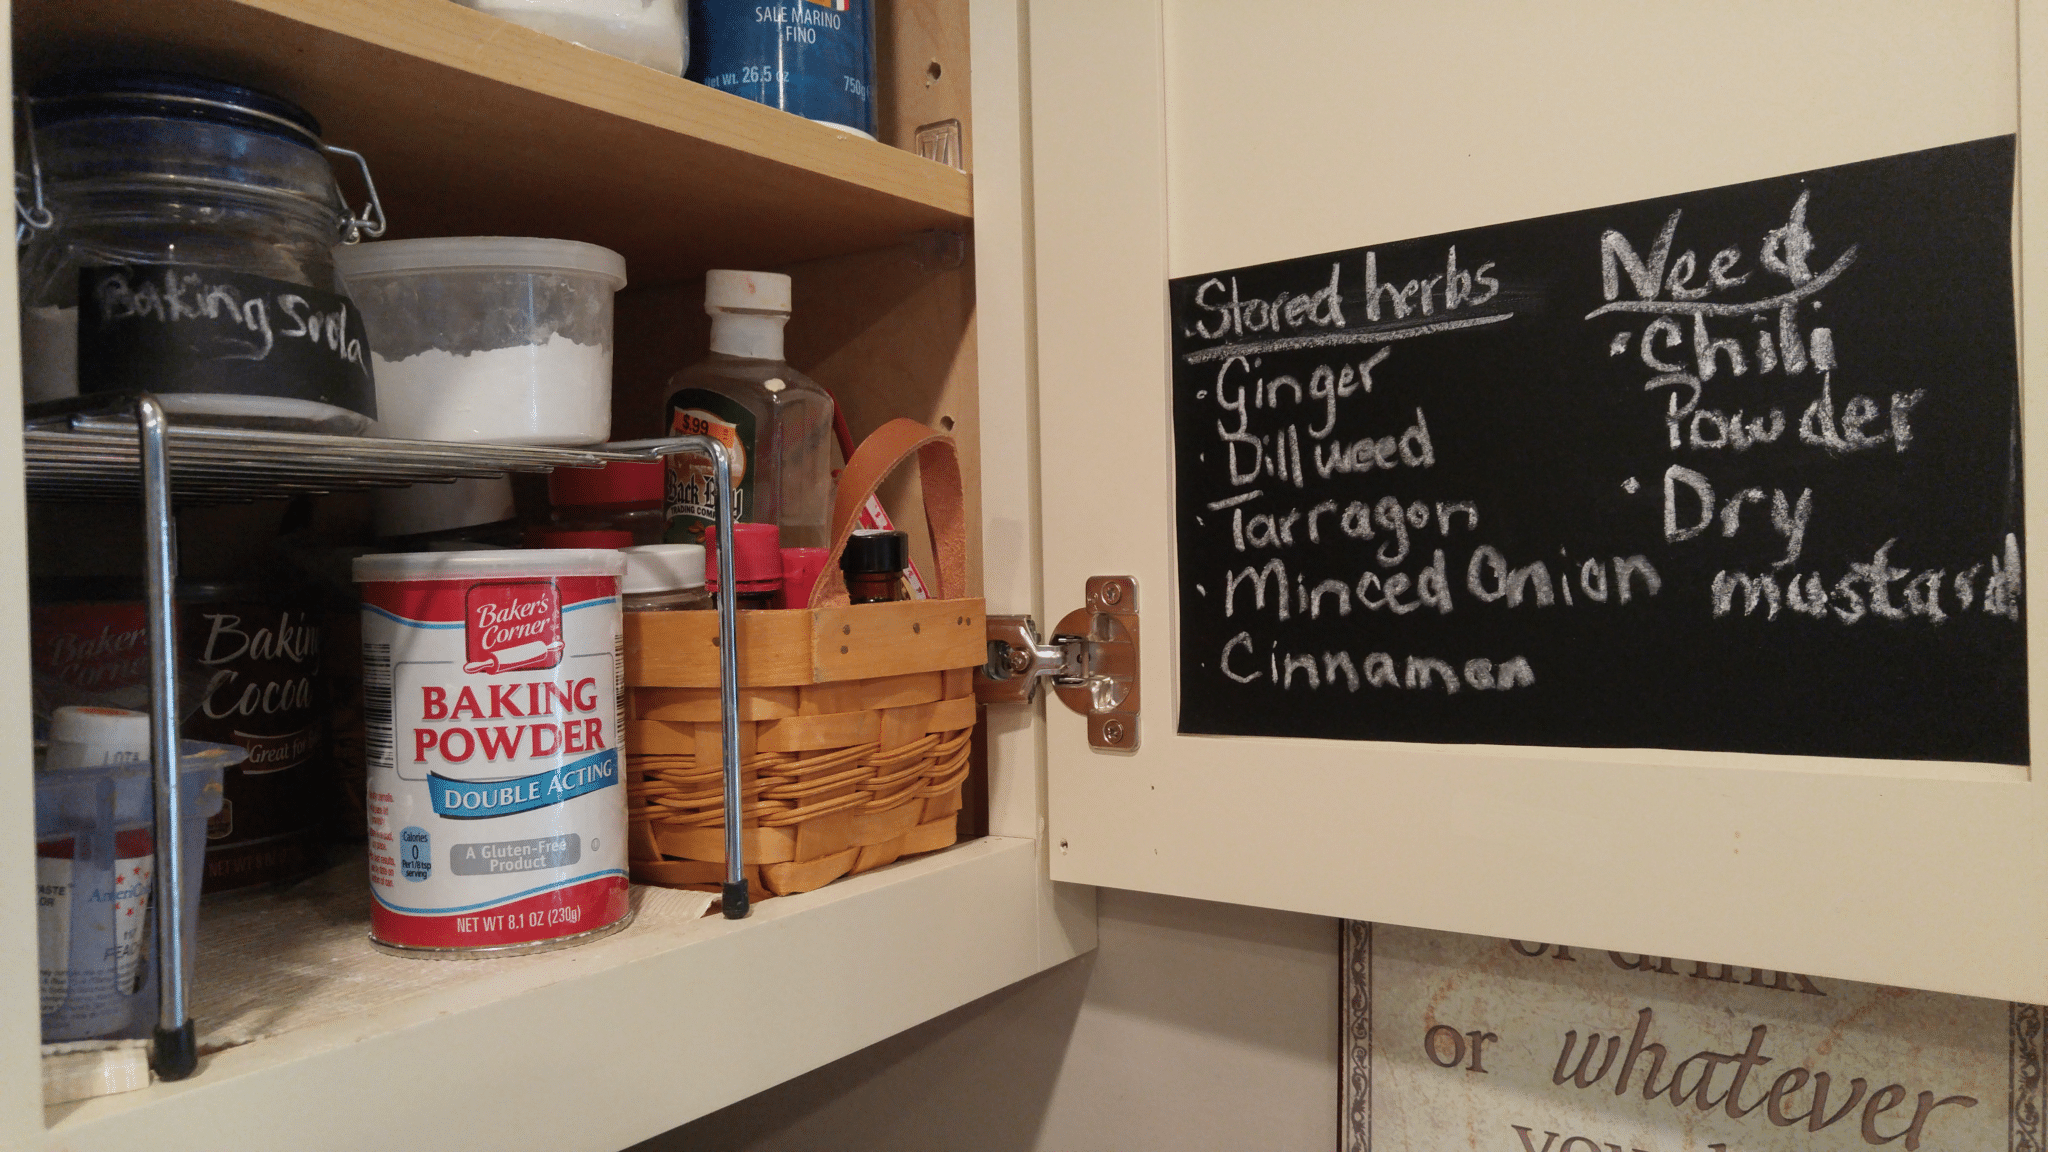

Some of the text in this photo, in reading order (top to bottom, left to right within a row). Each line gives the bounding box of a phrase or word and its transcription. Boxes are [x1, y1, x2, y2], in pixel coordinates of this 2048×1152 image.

[755, 6, 841, 31] SALE MARINO
[785, 26, 816, 44] FINO
[742, 65, 772, 84] 26.5
[1600, 189, 1815, 300] Need
[102, 269, 274, 361] Baking
[1195, 245, 1499, 340] Stored herbs
[1640, 298, 1838, 382] Chili
[1216, 346, 1391, 441] Ginger
[1645, 372, 1927, 460] Powder
[670, 503, 696, 516] TRADING
[1208, 490, 1479, 567] Tarragon
[1663, 464, 1813, 568] Dry
[1225, 544, 1662, 622] Minced Onion
[1711, 532, 2019, 624] mustard
[476, 593, 549, 629] Baker's
[481, 617, 551, 650] Corner
[1220, 631, 1535, 695] Cinnamon
[202, 668, 313, 720] Cocoa
[420, 677, 598, 721] BAKING
[248, 743, 290, 765] Great
[413, 717, 606, 763] POWDER
[444, 759, 613, 809] DOUBLE ACTING
[404, 831, 428, 843] Calories
[465, 839, 567, 860] A Gluten-Free
[405, 870, 428, 880] serving
[490, 854, 547, 872] Product
[456, 905, 582, 933] NET WT 8.1 OZ (230g)
[1424, 1021, 1498, 1074] or
[1551, 1006, 1979, 1152] whatever
